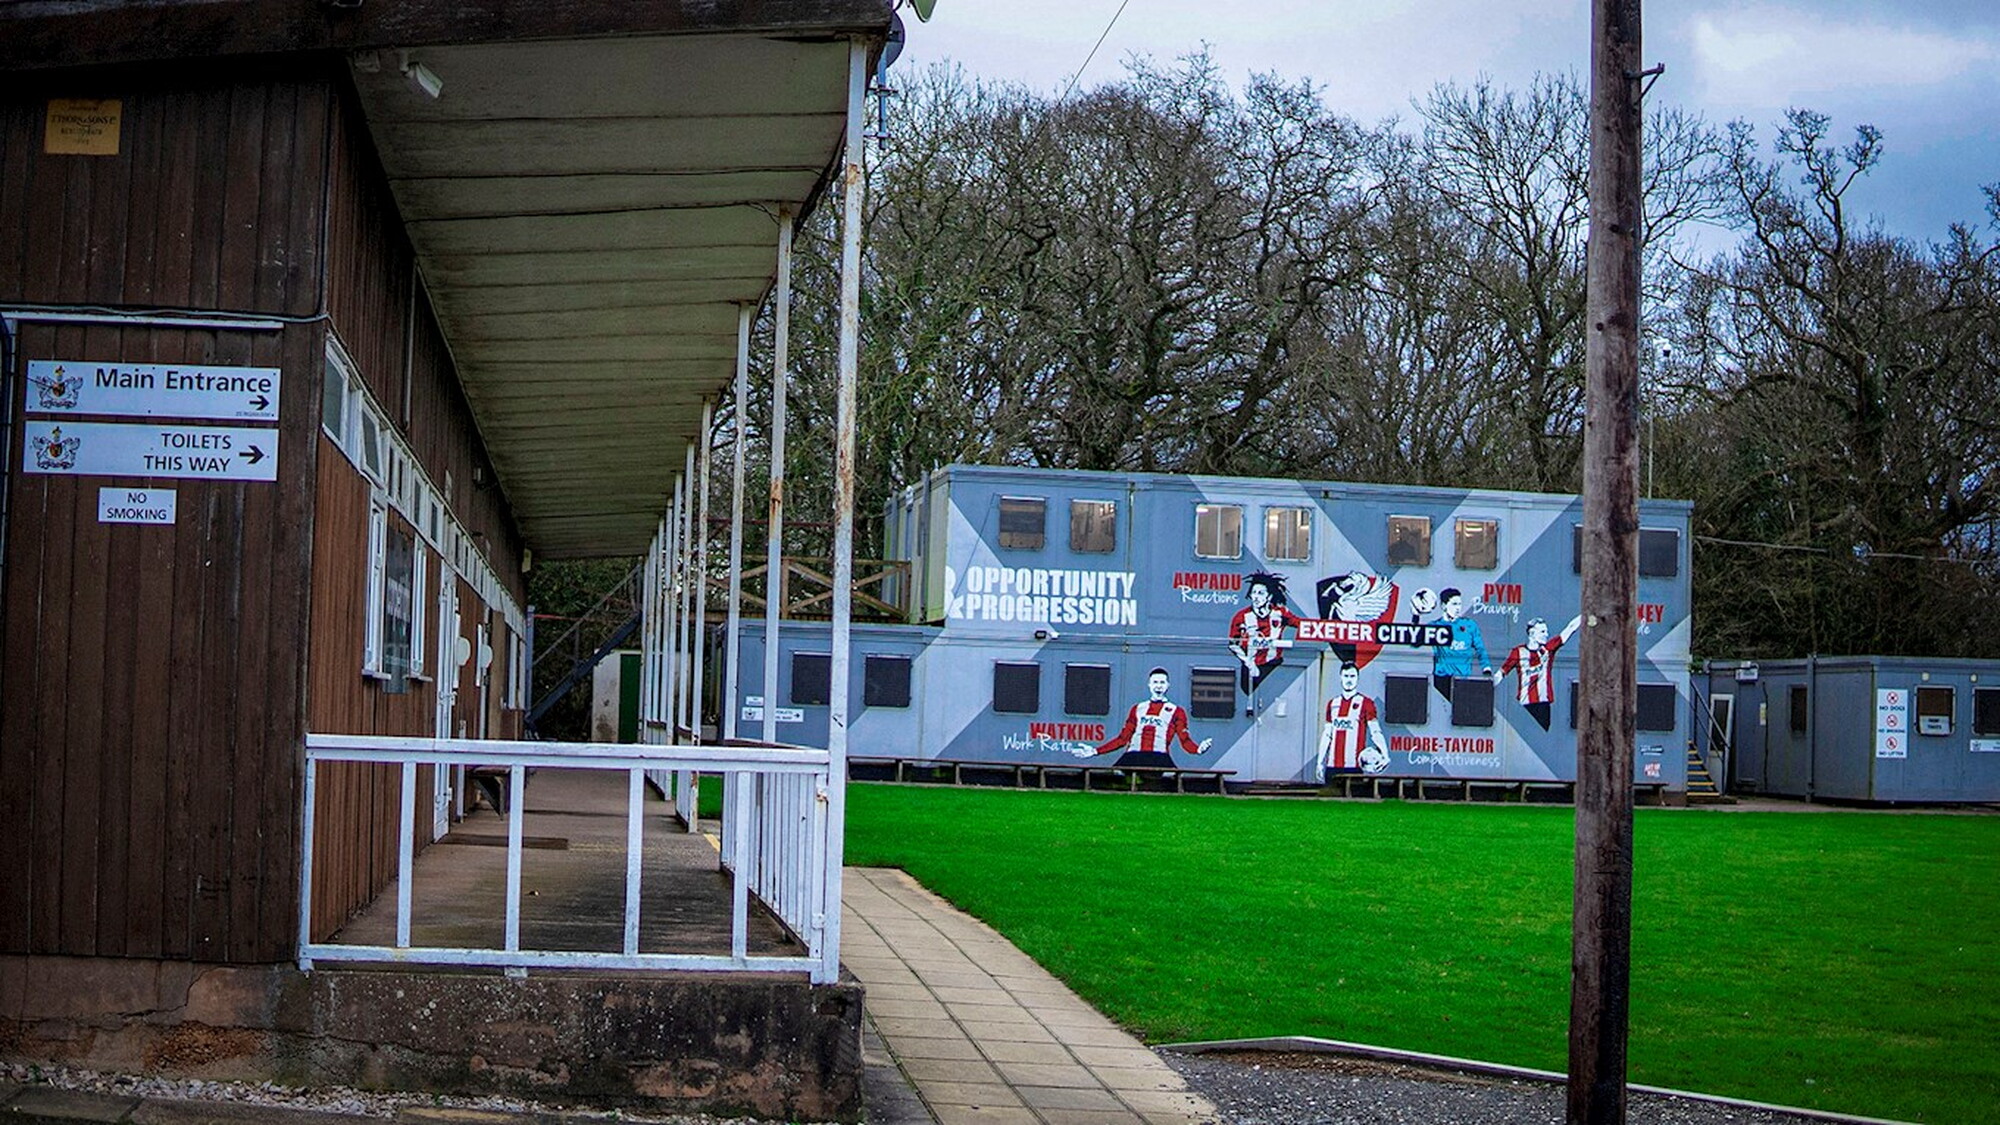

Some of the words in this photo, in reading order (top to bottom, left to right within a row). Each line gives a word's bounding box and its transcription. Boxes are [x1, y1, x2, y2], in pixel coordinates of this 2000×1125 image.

[95, 368, 154, 389] Main
[165, 370, 272, 393] Entrance
[161, 432, 232, 449] TOILETS
[144, 455, 182, 471] THIS
[189, 457, 231, 472] WAY
[127, 492, 147, 504] NO
[106, 508, 167, 521] SMOKING
[967, 566, 1136, 597] OPPORTUNITY
[1173, 572, 1242, 591] AMPADU
[1178, 587, 1240, 605] Reactions
[1484, 583, 1522, 604] PYM
[965, 594, 1137, 626] PROGRESSION
[1473, 597, 1521, 622] Bravery
[1300, 622, 1373, 641] EXETER
[1378, 625, 1418, 644] CITY
[1425, 626, 1450, 645] FC
[1030, 723, 1105, 741] WATKINS
[1003, 735, 1033, 751] Work
[1038, 733, 1073, 752] Rate
[1390, 737, 1494, 754] MOORE-TAYLOR
[1409, 747, 1501, 773] Competitiveness
